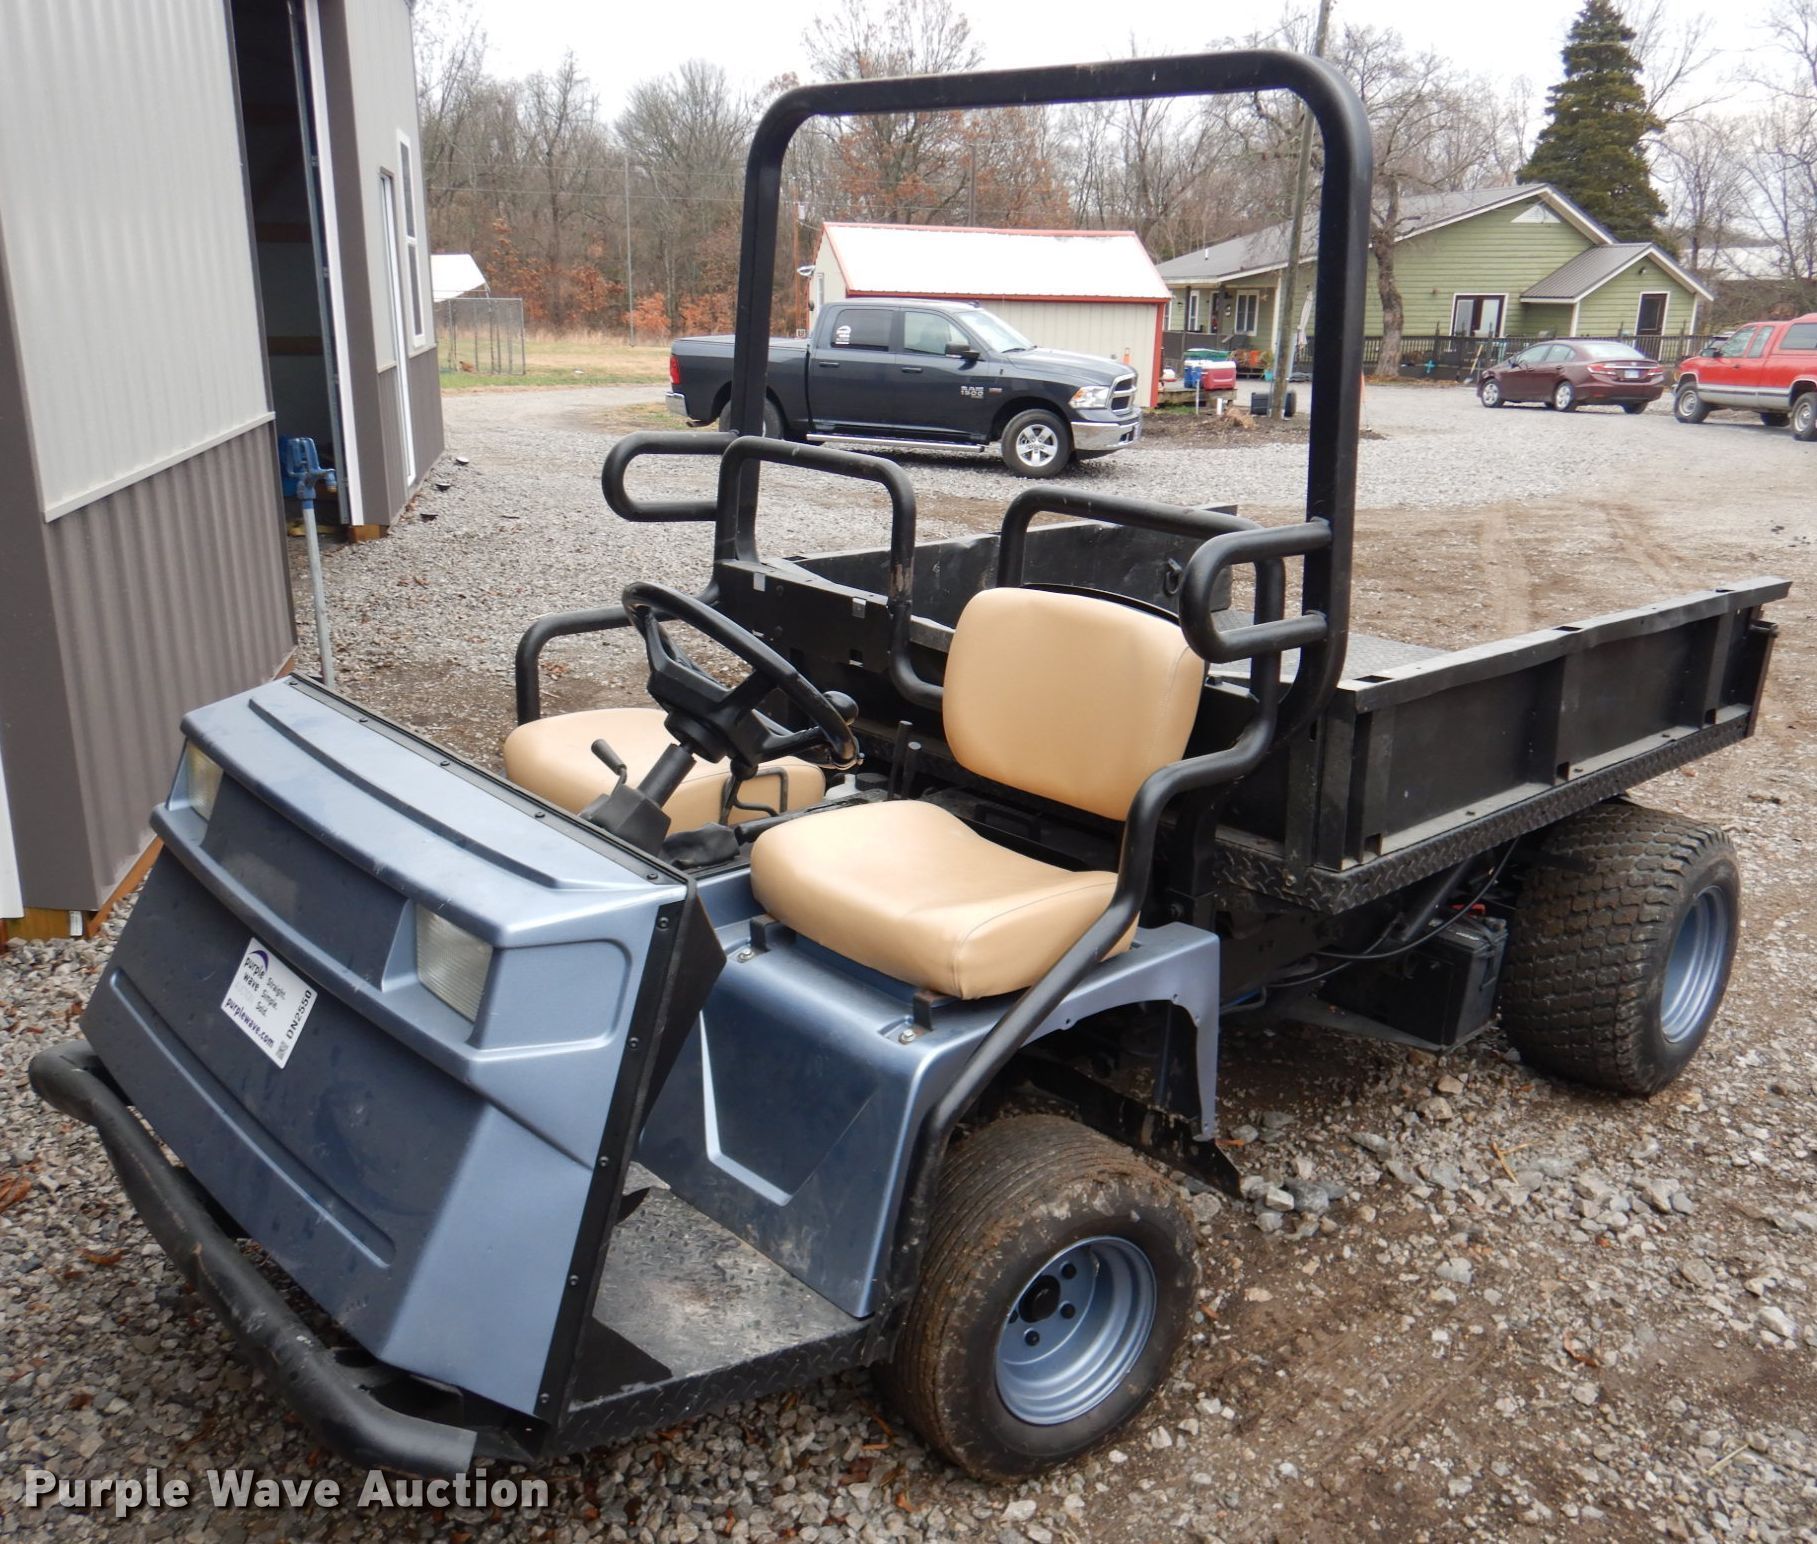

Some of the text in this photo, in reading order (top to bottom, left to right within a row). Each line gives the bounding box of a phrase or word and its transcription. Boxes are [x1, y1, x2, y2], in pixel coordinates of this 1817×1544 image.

[243, 973, 260, 991] wave
[245, 957, 265, 979] purple
[225, 998, 275, 1048] purplewave.com
[286, 990, 312, 1039] DN2550
